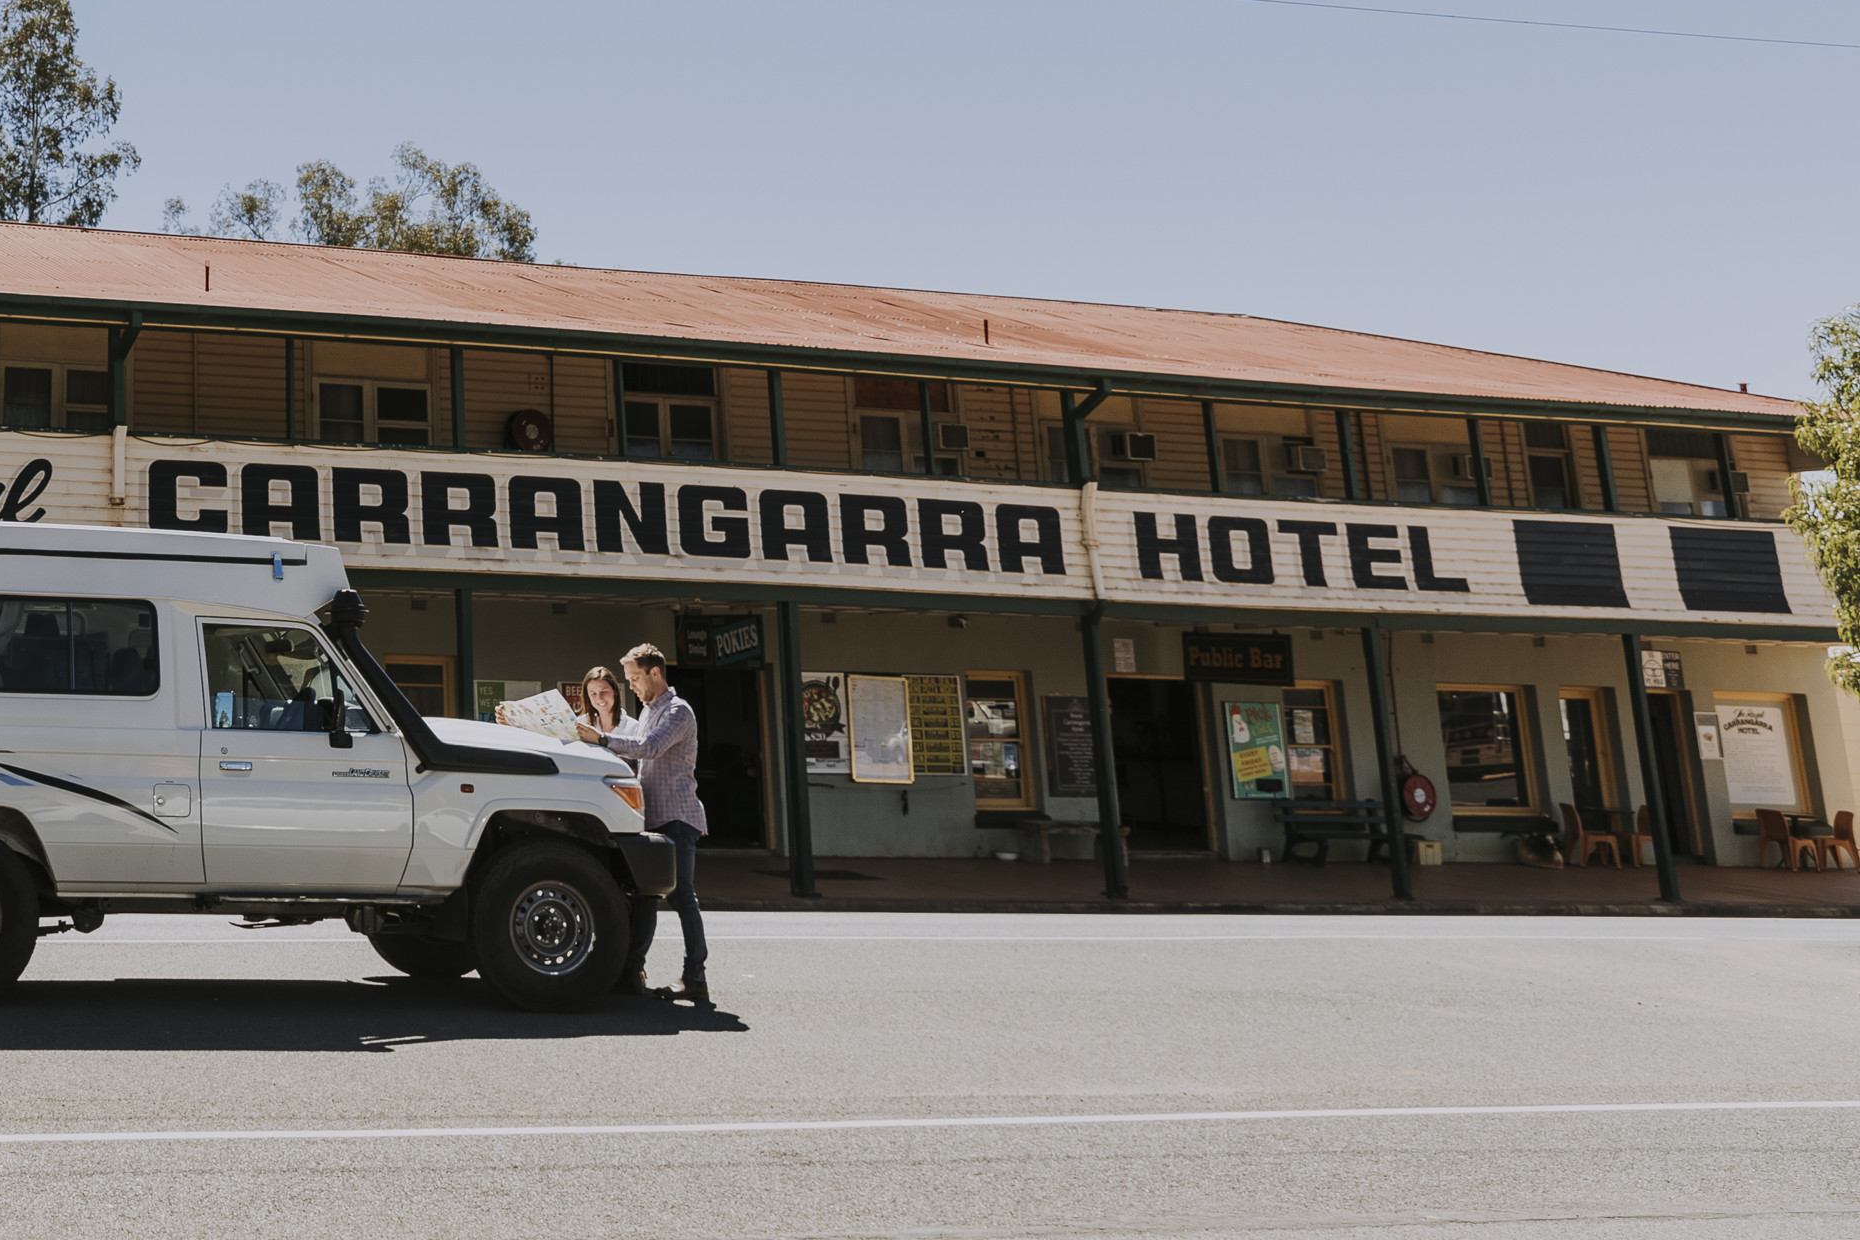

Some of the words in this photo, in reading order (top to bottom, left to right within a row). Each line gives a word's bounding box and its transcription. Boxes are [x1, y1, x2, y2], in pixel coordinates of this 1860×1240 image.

[147, 460, 1066, 576] CARRANGARRA
[1133, 510, 1471, 593] HOTEL
[715, 624, 758, 657] POKIES
[1188, 645, 1244, 669] Public
[1249, 647, 1283, 669] Bar
[479, 686, 493, 695] YES
[479, 698, 491, 707] WE
[1723, 718, 1773, 732] CARRANGARRA
[1738, 727, 1760, 735] HOTEL
